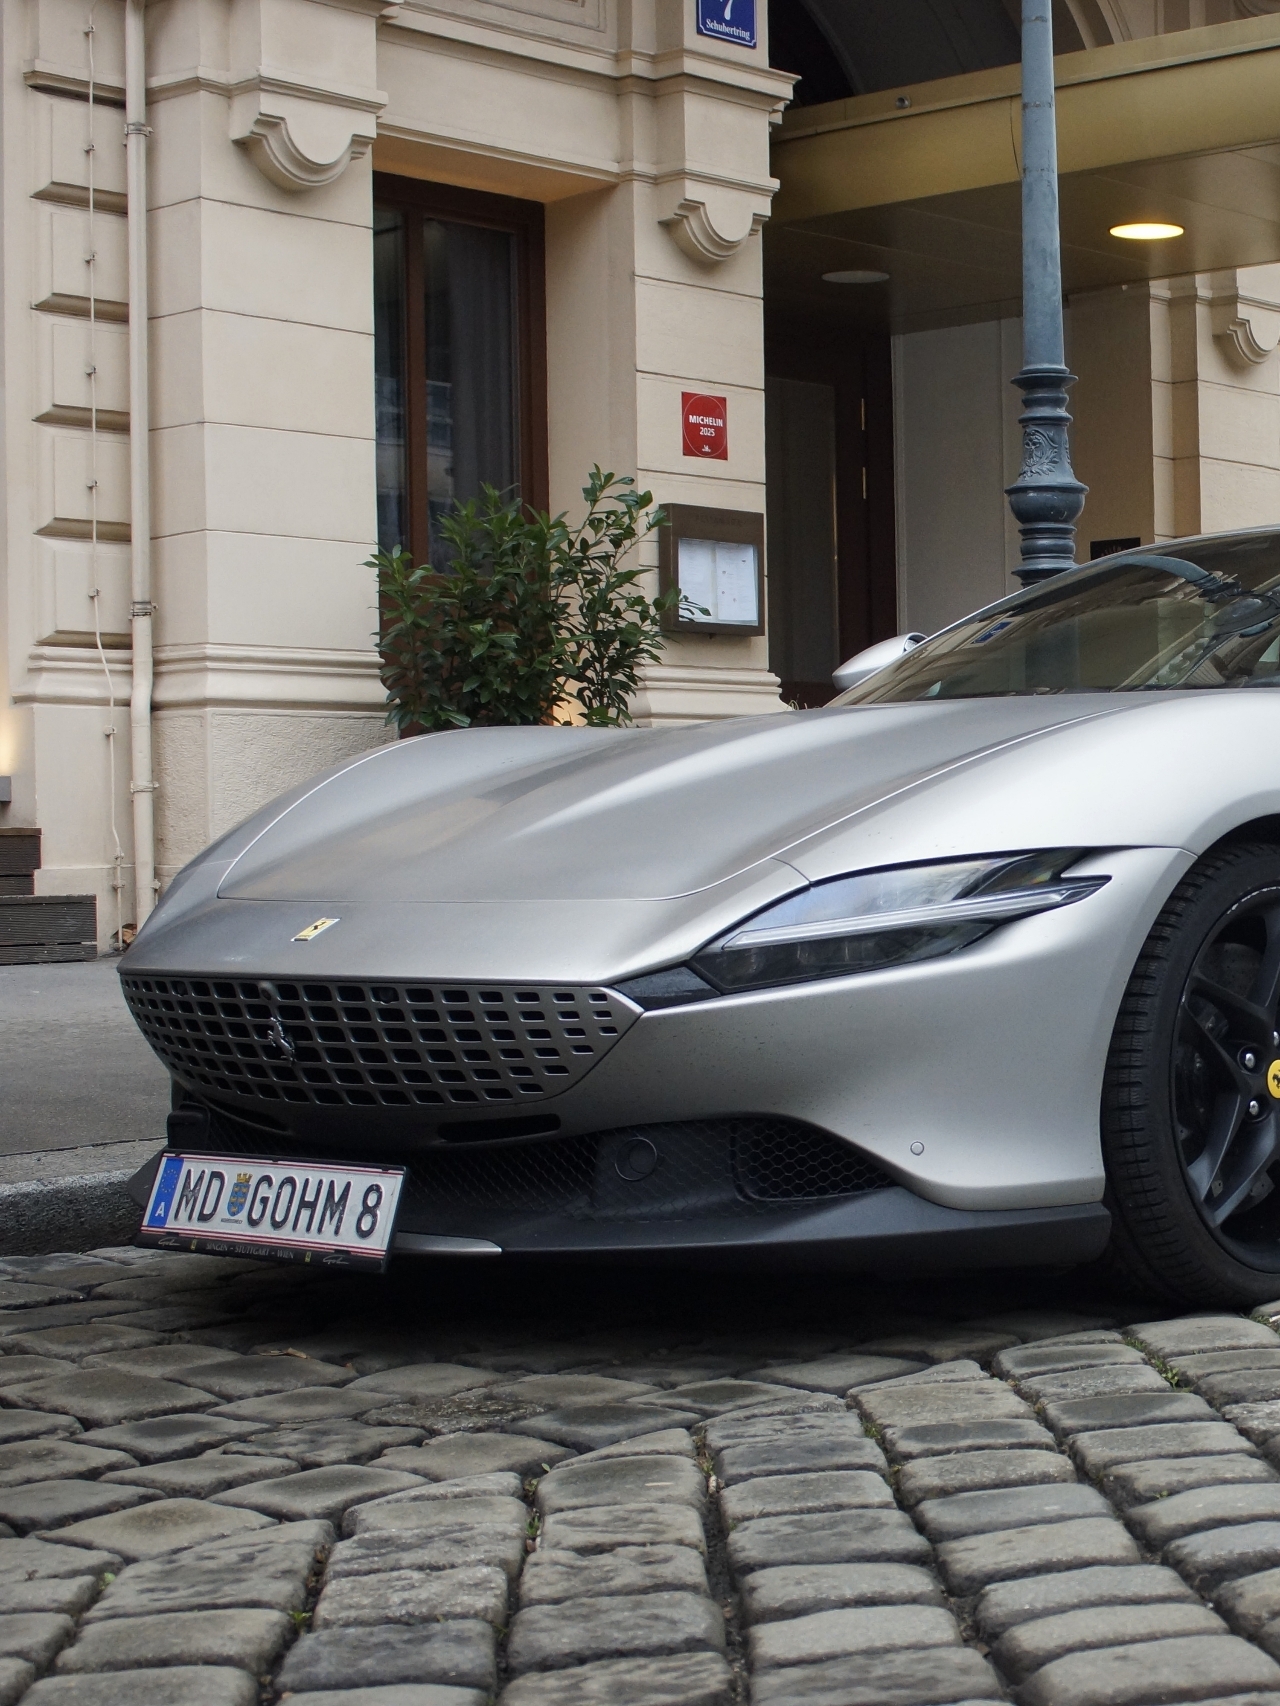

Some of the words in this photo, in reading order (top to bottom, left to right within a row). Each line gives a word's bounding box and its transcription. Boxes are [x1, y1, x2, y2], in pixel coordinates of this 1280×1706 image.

[706, 18, 750, 40] Schubertring
[689, 415, 723, 427] MICHELIN
[699, 427, 715, 437] 2025
[155, 1202, 165, 1218] A
[174, 1168, 227, 1223] MD
[247, 1174, 352, 1236] GOHM
[355, 1183, 383, 1239] 8
[206, 1242, 228, 1252] SINGEN
[234, 1245, 270, 1256] STUTTGART
[276, 1249, 294, 1260] WIEN
